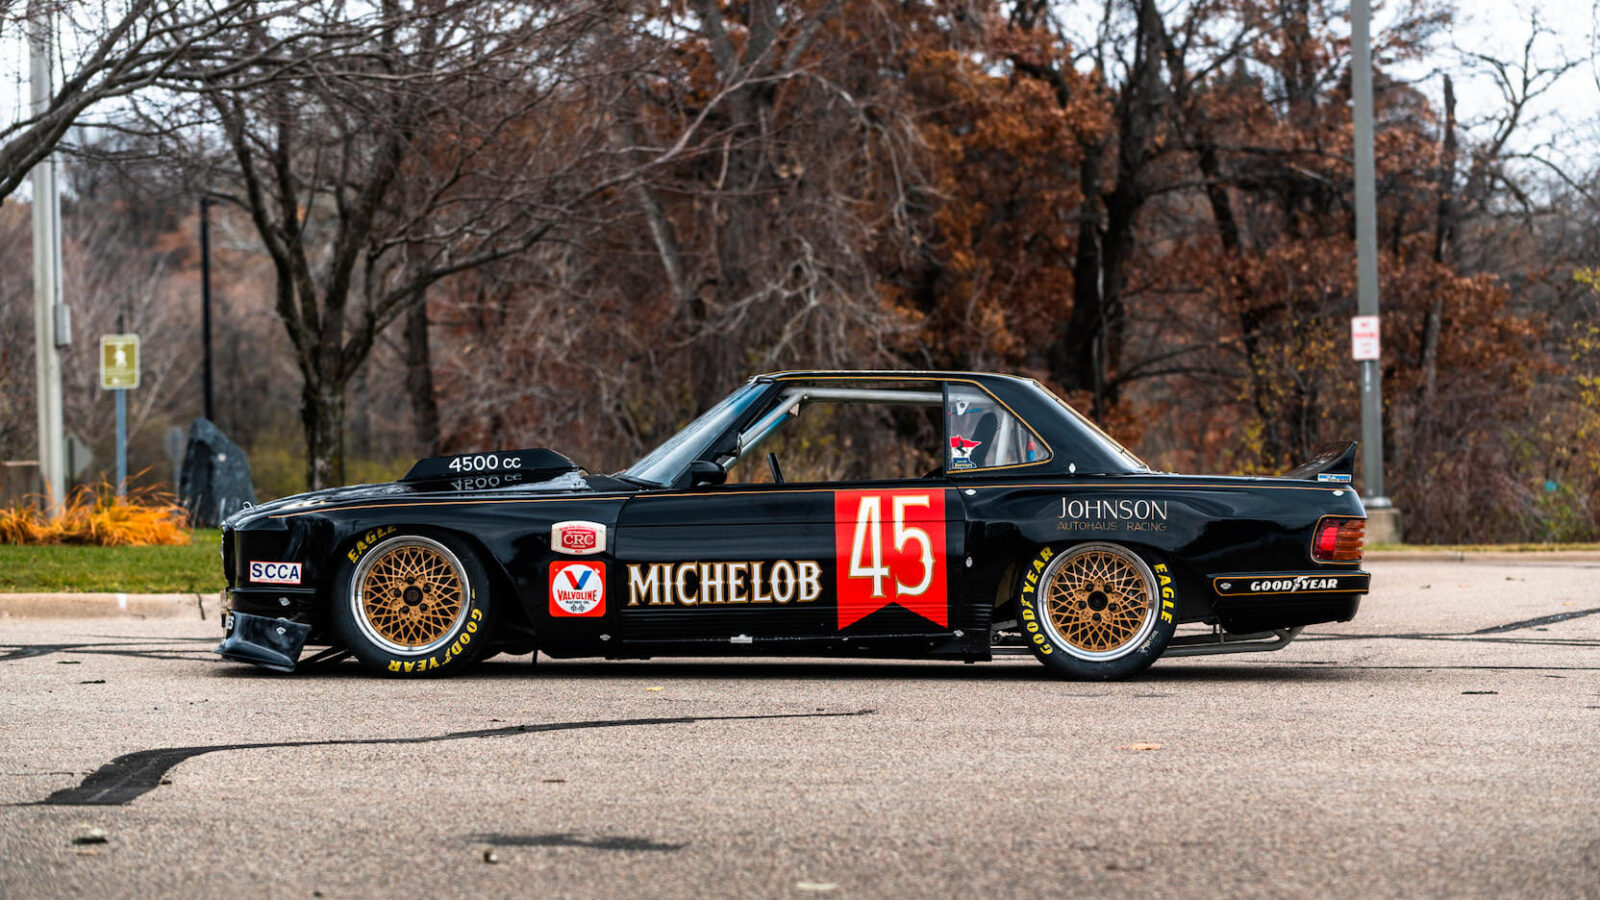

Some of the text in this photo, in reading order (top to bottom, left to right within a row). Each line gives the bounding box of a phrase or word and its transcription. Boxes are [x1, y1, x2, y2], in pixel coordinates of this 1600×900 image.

[448, 454, 499, 472] 4500
[1057, 497, 1168, 520] JOHNSON
[1057, 521, 1168, 532] AUTOHAUS RACING
[347, 524, 398, 564] EAGLE
[563, 534, 595, 546] CRC
[848, 494, 936, 599] 45
[251, 563, 300, 580] SCCA
[626, 559, 824, 606] MICHELOB
[557, 589, 598, 602] VALVOLINE
[1153, 563, 1175, 625] EAGLE
[1250, 577, 1339, 592] GOODYEAR
[1020, 546, 1054, 655] GOODYEAR
[388, 608, 483, 673] GOODYEAR
